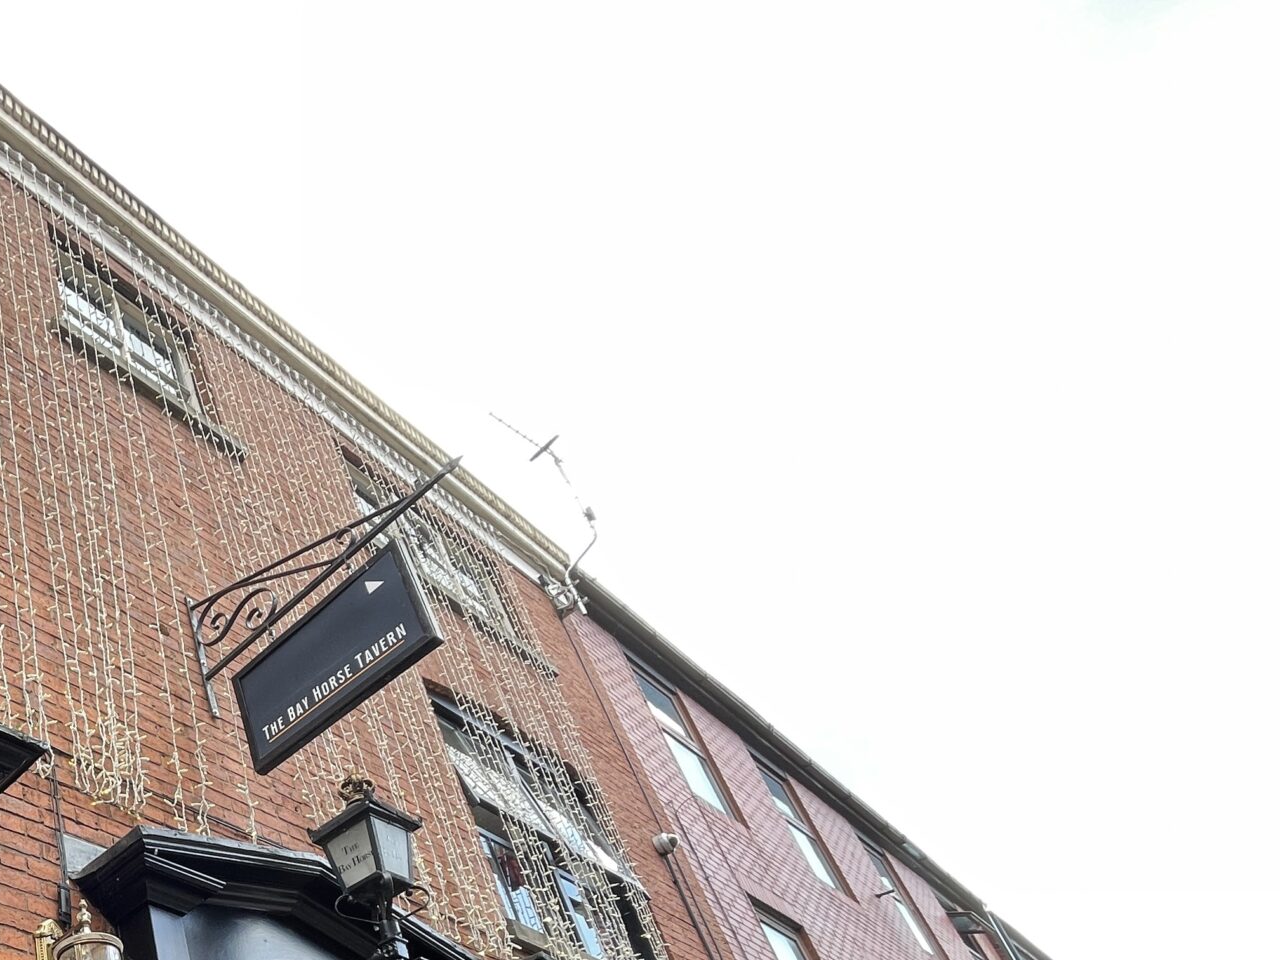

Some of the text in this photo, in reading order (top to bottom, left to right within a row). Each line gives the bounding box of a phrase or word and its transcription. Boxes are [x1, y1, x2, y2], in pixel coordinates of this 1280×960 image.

[262, 623, 407, 740] THE BAY HORSE TAVERN
